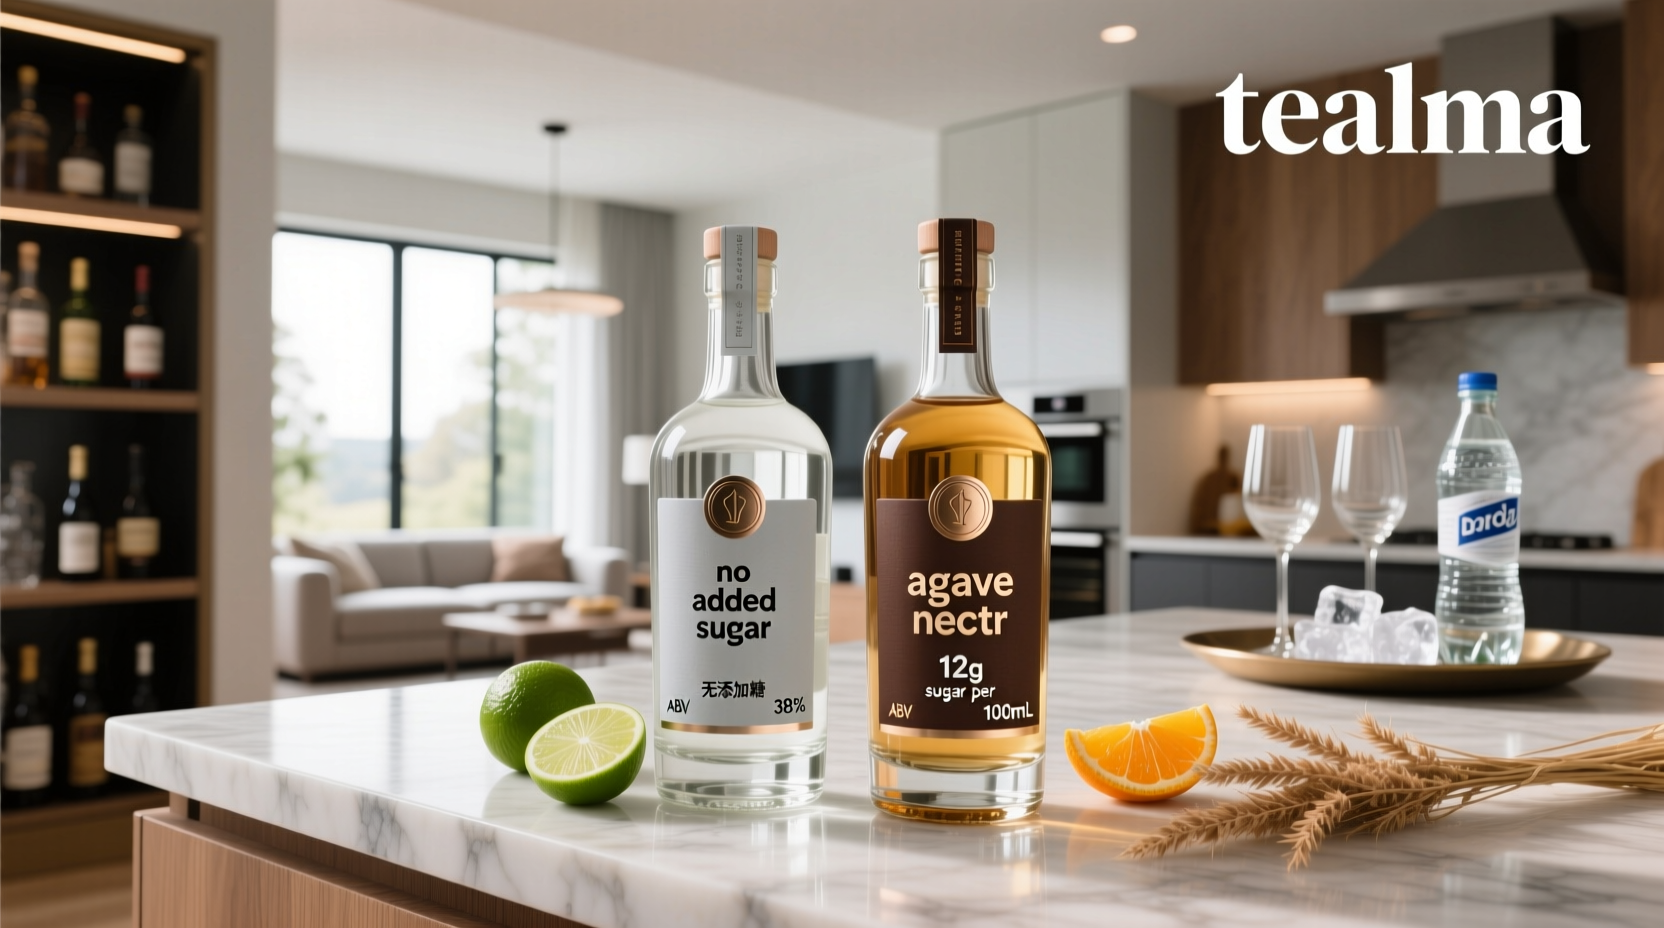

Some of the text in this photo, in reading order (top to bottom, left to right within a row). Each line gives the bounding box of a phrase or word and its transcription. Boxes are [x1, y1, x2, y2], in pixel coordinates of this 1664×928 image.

[717, 565, 751, 582] no
[692, 587, 776, 612] added
[907, 571, 1014, 608] agave
[913, 606, 1008, 636] nectr
[696, 620, 771, 646] sugar
[939, 654, 984, 684] 12g
[701, 679, 766, 699] 无添加糖
[925, 686, 996, 703] sugar per
[667, 697, 806, 714] ABV 38%
[888, 701, 1034, 720] ABV 100mL
